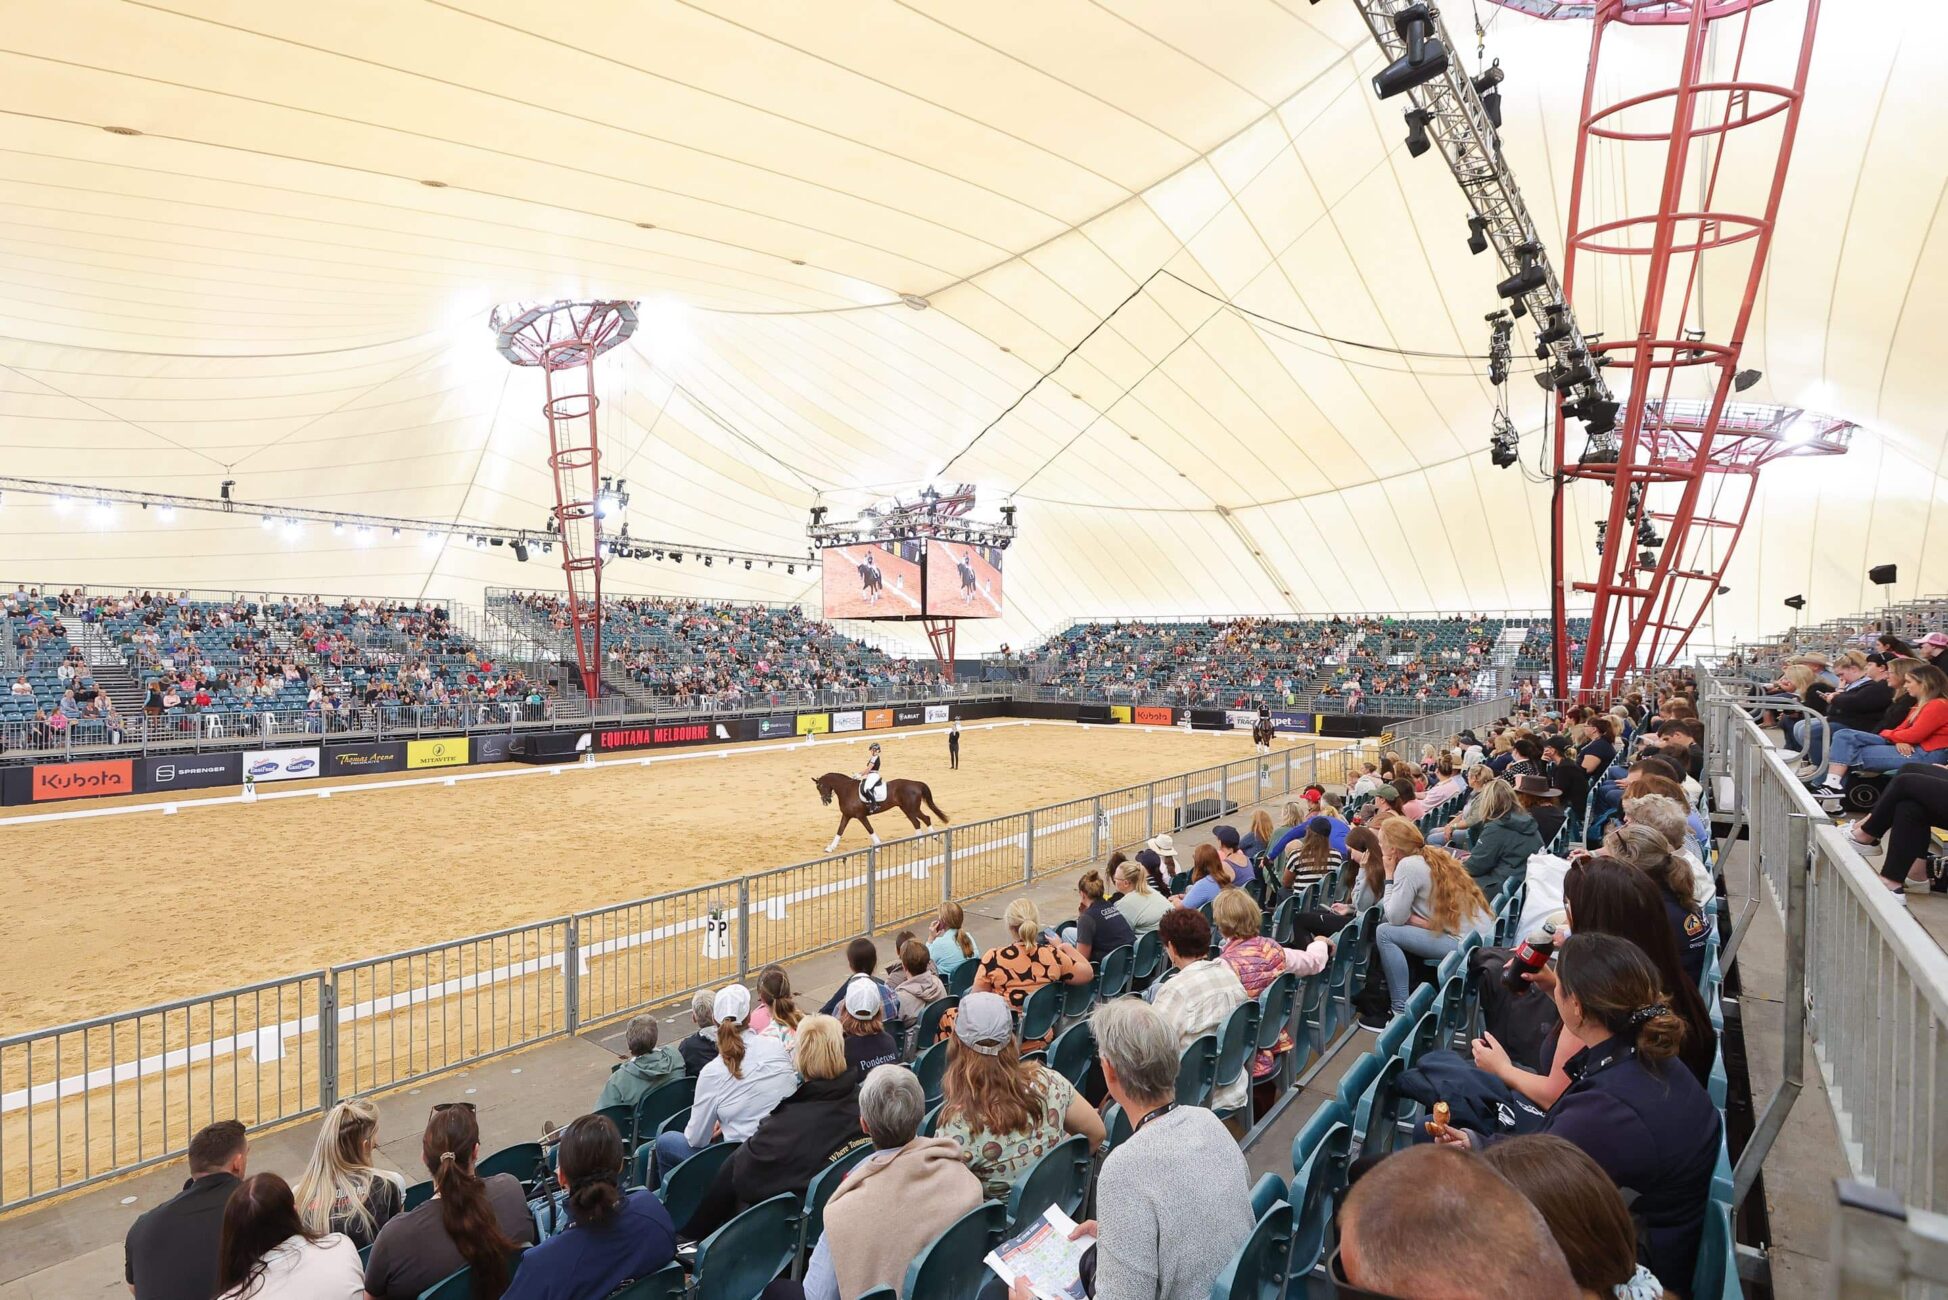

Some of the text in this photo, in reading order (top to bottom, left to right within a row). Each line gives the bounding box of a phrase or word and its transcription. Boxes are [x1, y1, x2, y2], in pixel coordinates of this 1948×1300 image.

[1137, 711, 1168, 720] Kubota
[601, 725, 709, 749] EQUITANA MELBOURNE
[335, 753, 394, 765] Thomas Arena
[420, 756, 456, 764] MITAVITE
[178, 766, 225, 775] SPRENGER
[42, 771, 122, 789] Kubota
[246, 785, 253, 793] V
[719, 921, 727, 938] P
[828, 1145, 850, 1163] Where
